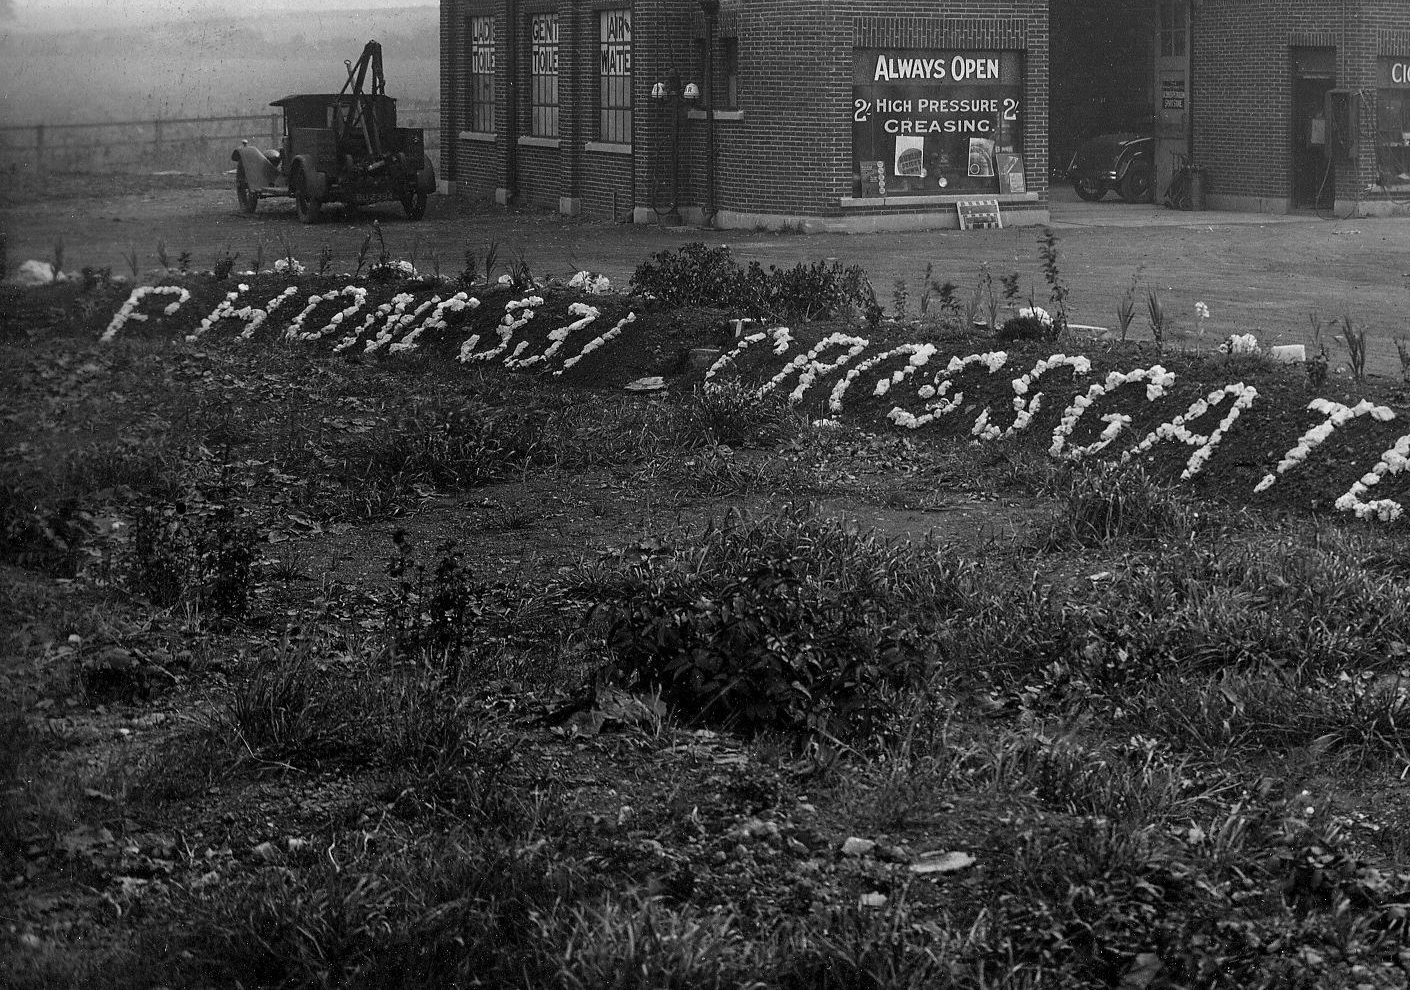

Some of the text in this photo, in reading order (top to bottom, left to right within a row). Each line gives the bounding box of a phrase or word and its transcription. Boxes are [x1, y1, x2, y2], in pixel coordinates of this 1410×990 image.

[874, 54, 999, 81] ALWAYS OPEN
[876, 98, 998, 113] HIGH PRESSURE
[884, 119, 996, 133] GREASING.
[100, 284, 481, 354] PHONE
